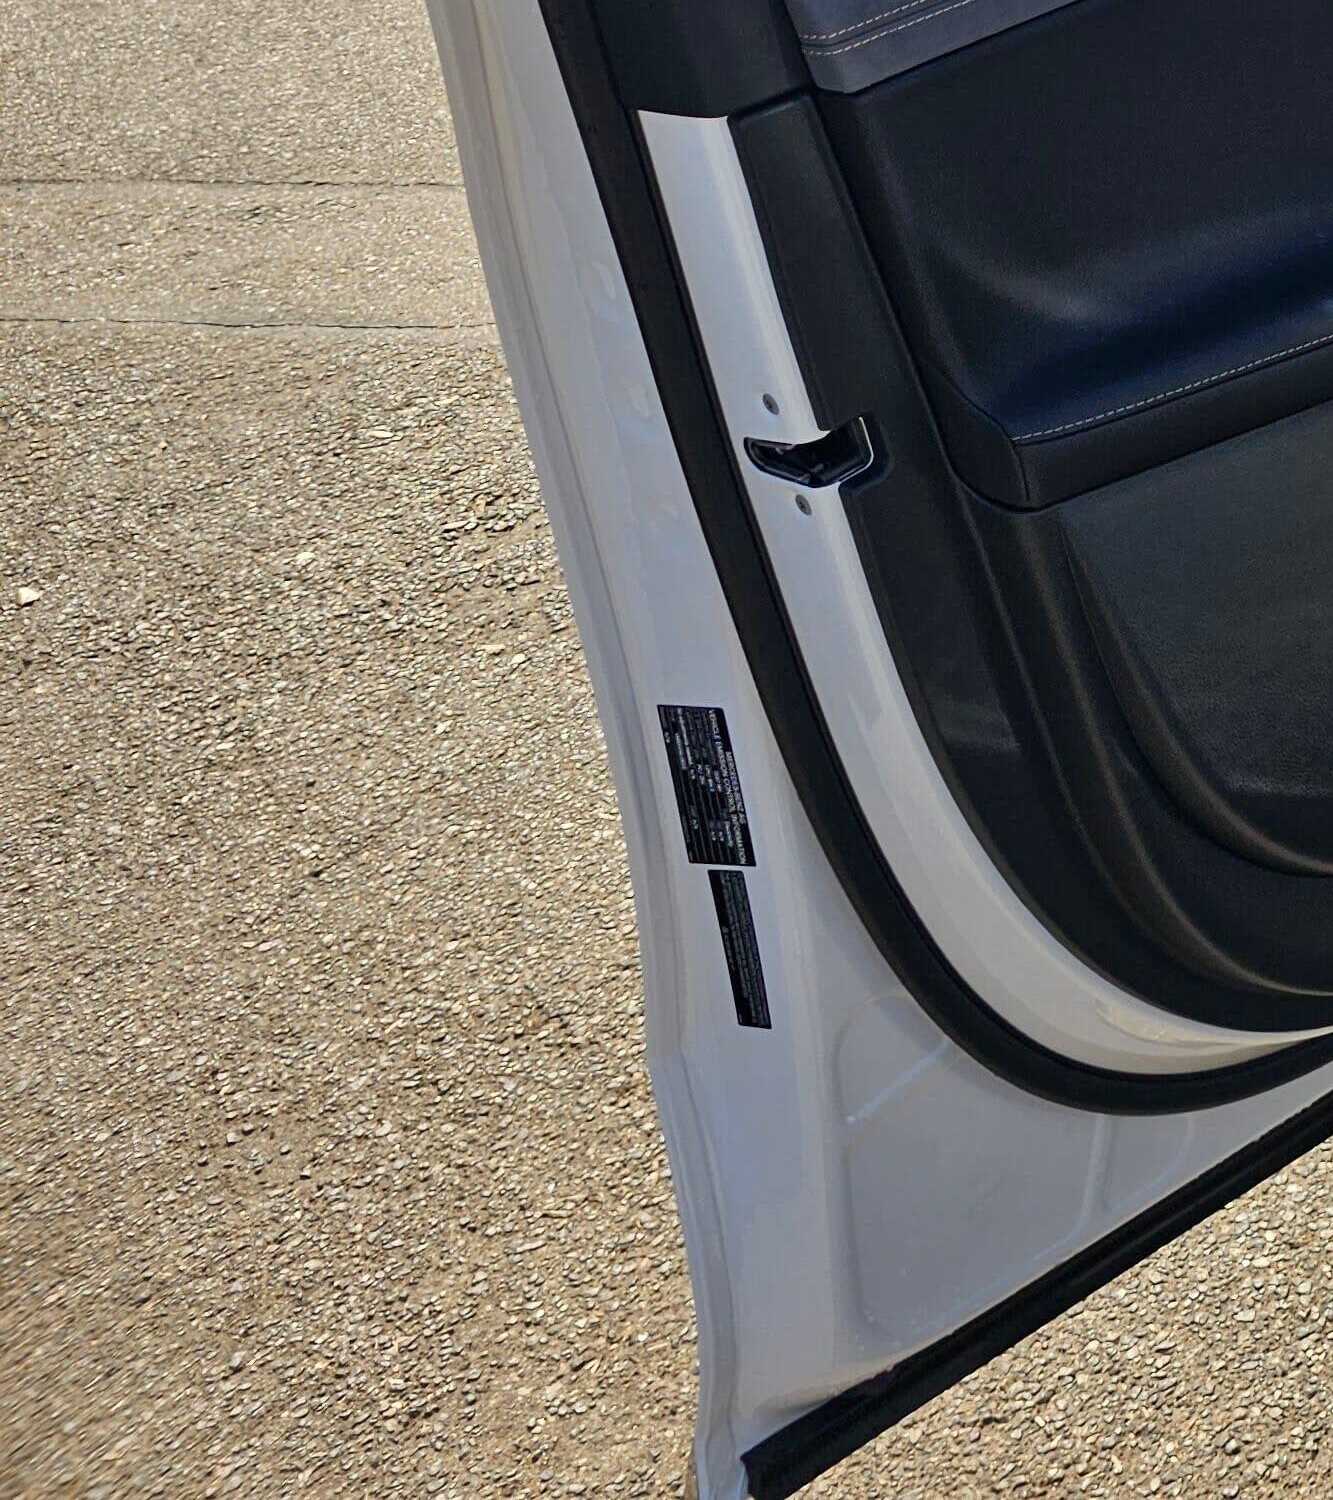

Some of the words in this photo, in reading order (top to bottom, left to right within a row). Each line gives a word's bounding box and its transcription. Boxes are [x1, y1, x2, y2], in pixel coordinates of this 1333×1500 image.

[708, 709, 721, 739] VEHICLE
[715, 741, 728, 777] EMISSION
[723, 779, 736, 812] CONTROL
[731, 814, 747, 864] INFORMATION
